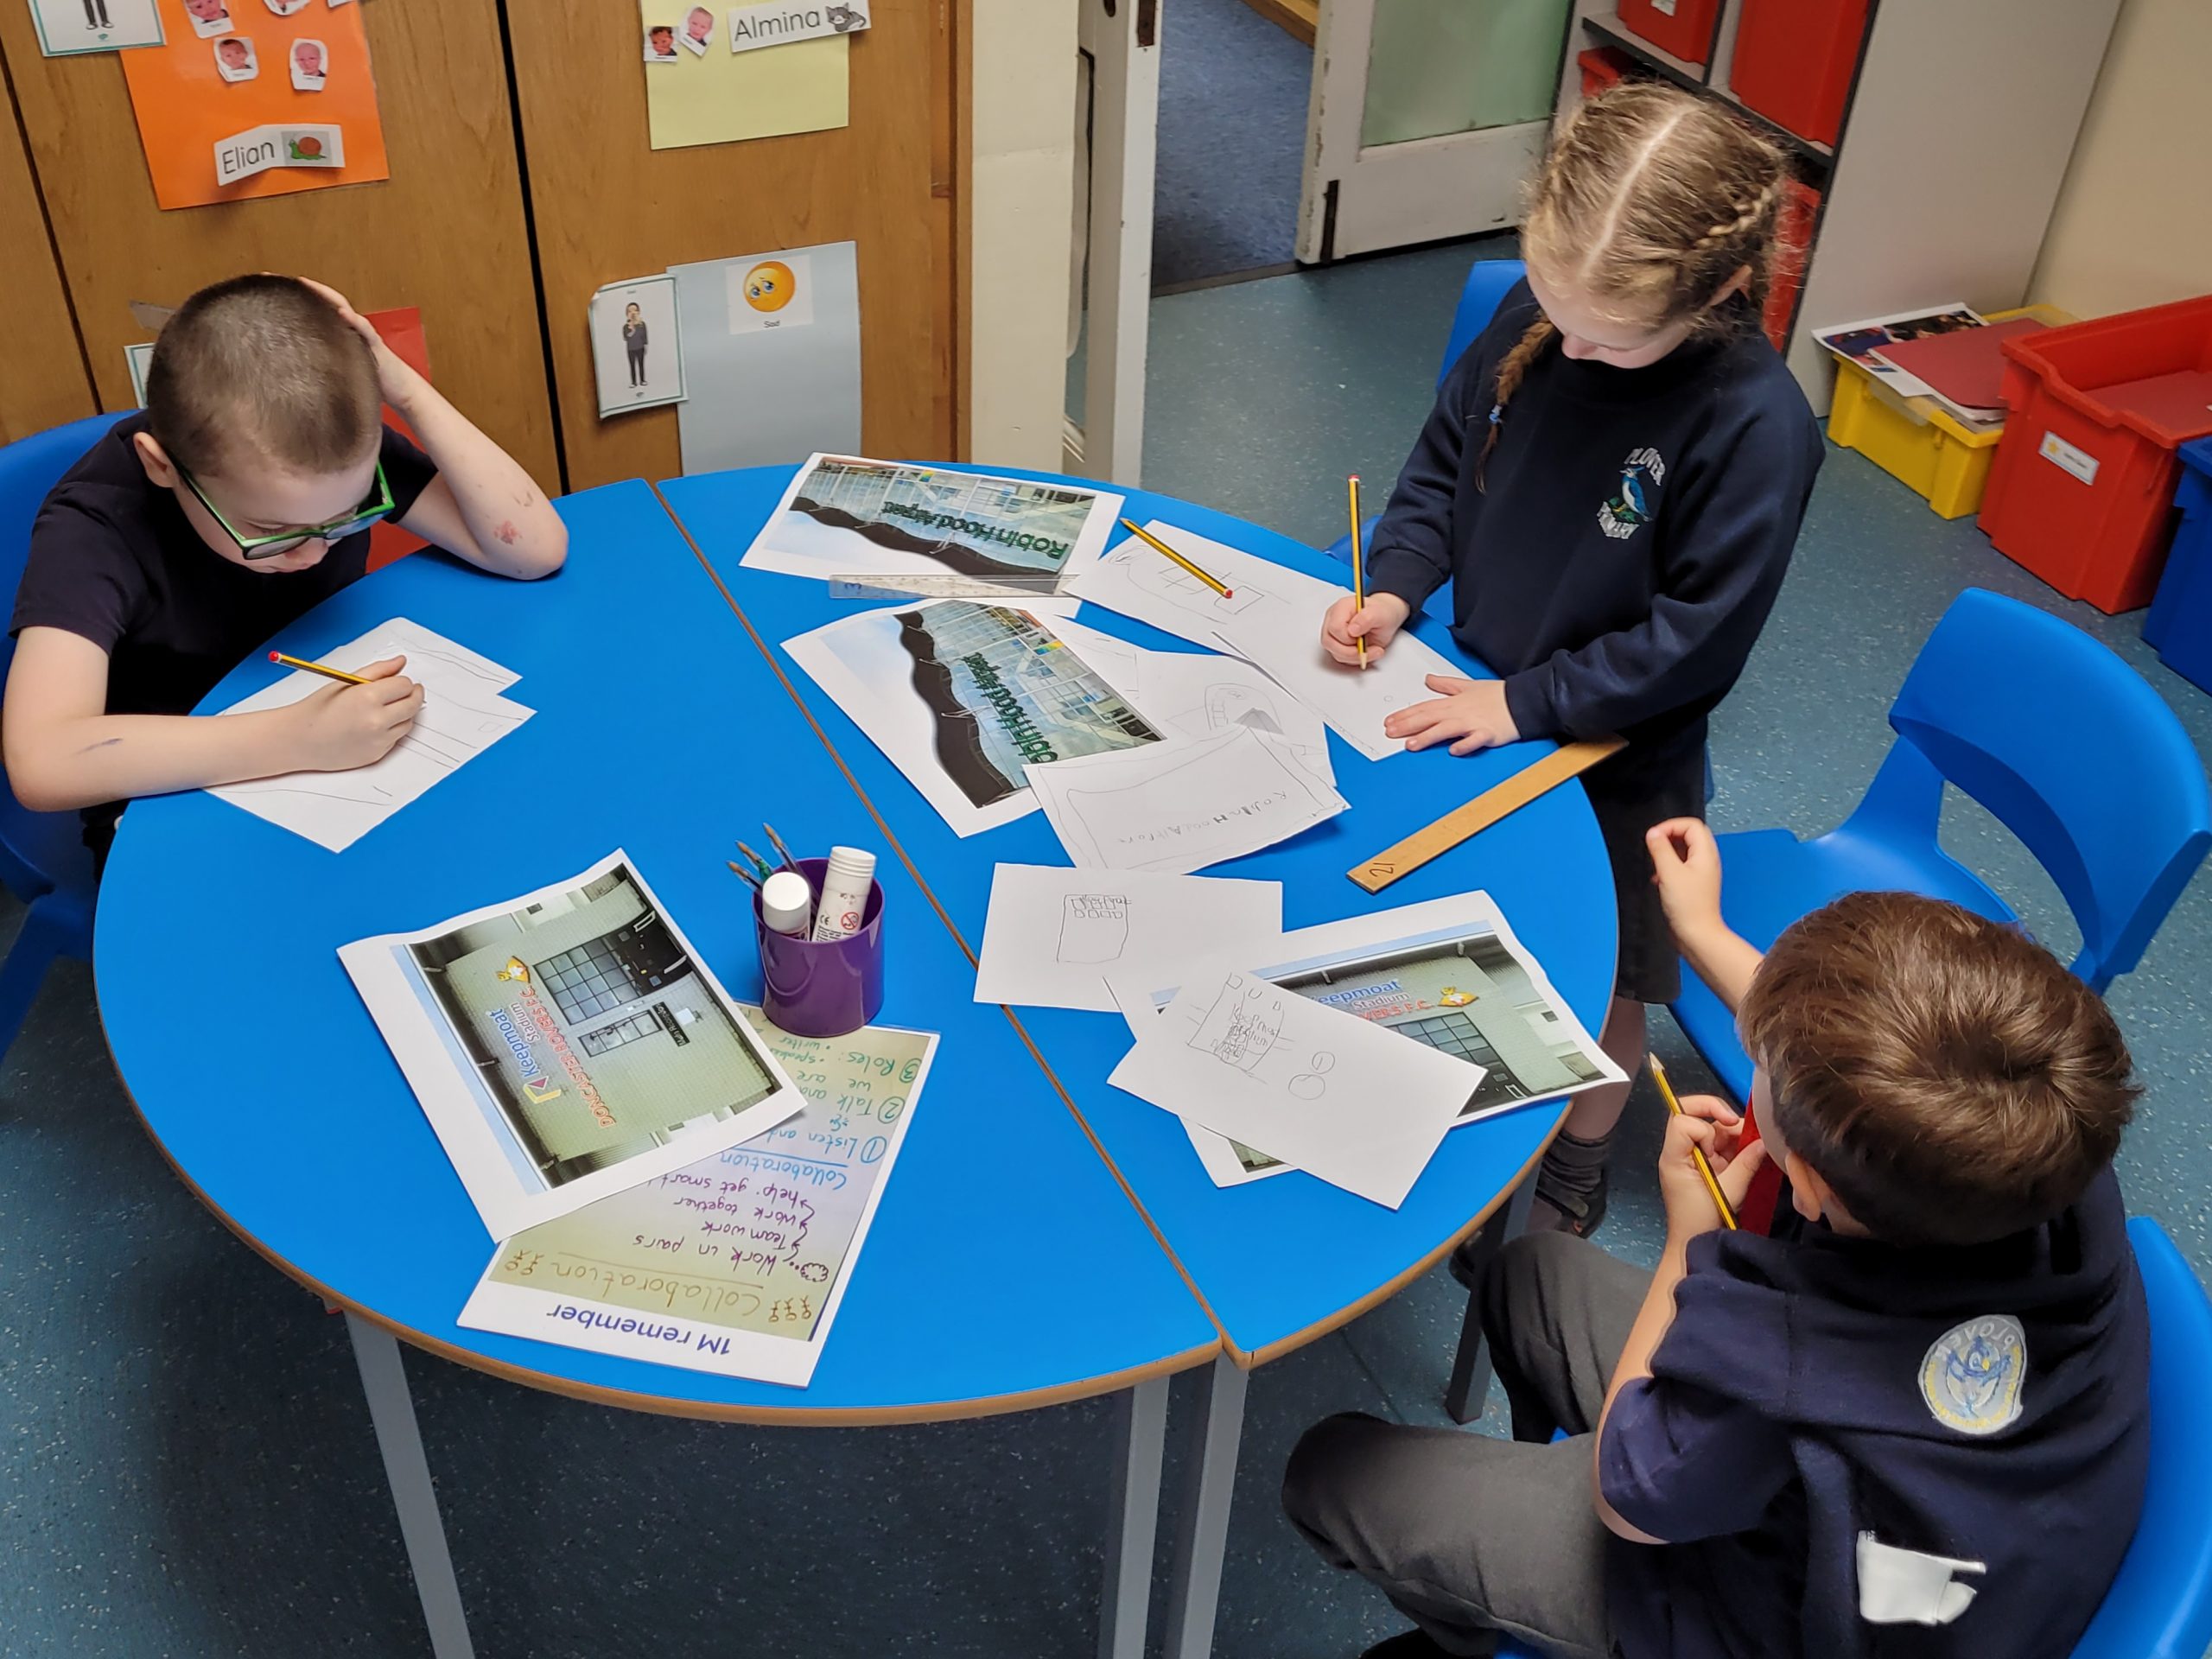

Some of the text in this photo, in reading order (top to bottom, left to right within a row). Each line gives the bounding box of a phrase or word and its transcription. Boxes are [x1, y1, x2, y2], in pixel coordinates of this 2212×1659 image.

[734, 10, 820, 41] Almina
[222, 142, 275, 175] Elian
[763, 320, 780, 328] Sad
[1624, 447, 1666, 486] PLOVER
[936, 515, 995, 542] Hood
[996, 528, 1069, 560] Robin
[981, 688, 1037, 730] Hood
[1011, 730, 1058, 764] obin
[1311, 980, 1402, 1004] eepmoat
[1351, 992, 1410, 1010] Stadium
[510, 1002, 541, 1044] Stadium
[531, 1006, 569, 1052] ROVERS
[1357, 1005, 1402, 1021] VERS
[490, 1008, 540, 1078] Keepmoat
[779, 1037, 821, 1050] writer
[559, 1050, 617, 1128] DONCASTER
[797, 1071, 871, 1092] we are
[836, 1093, 873, 1116] Talk
[808, 1133, 858, 1160] Listen
[719, 1178, 749, 1194] get
[721, 1151, 847, 1191] Collaboration
[673, 1196, 738, 1216] together
[632, 1234, 777, 1276] Work in pairs
[550, 1262, 761, 1317] Collaboration
[546, 1304, 692, 1344] remember
